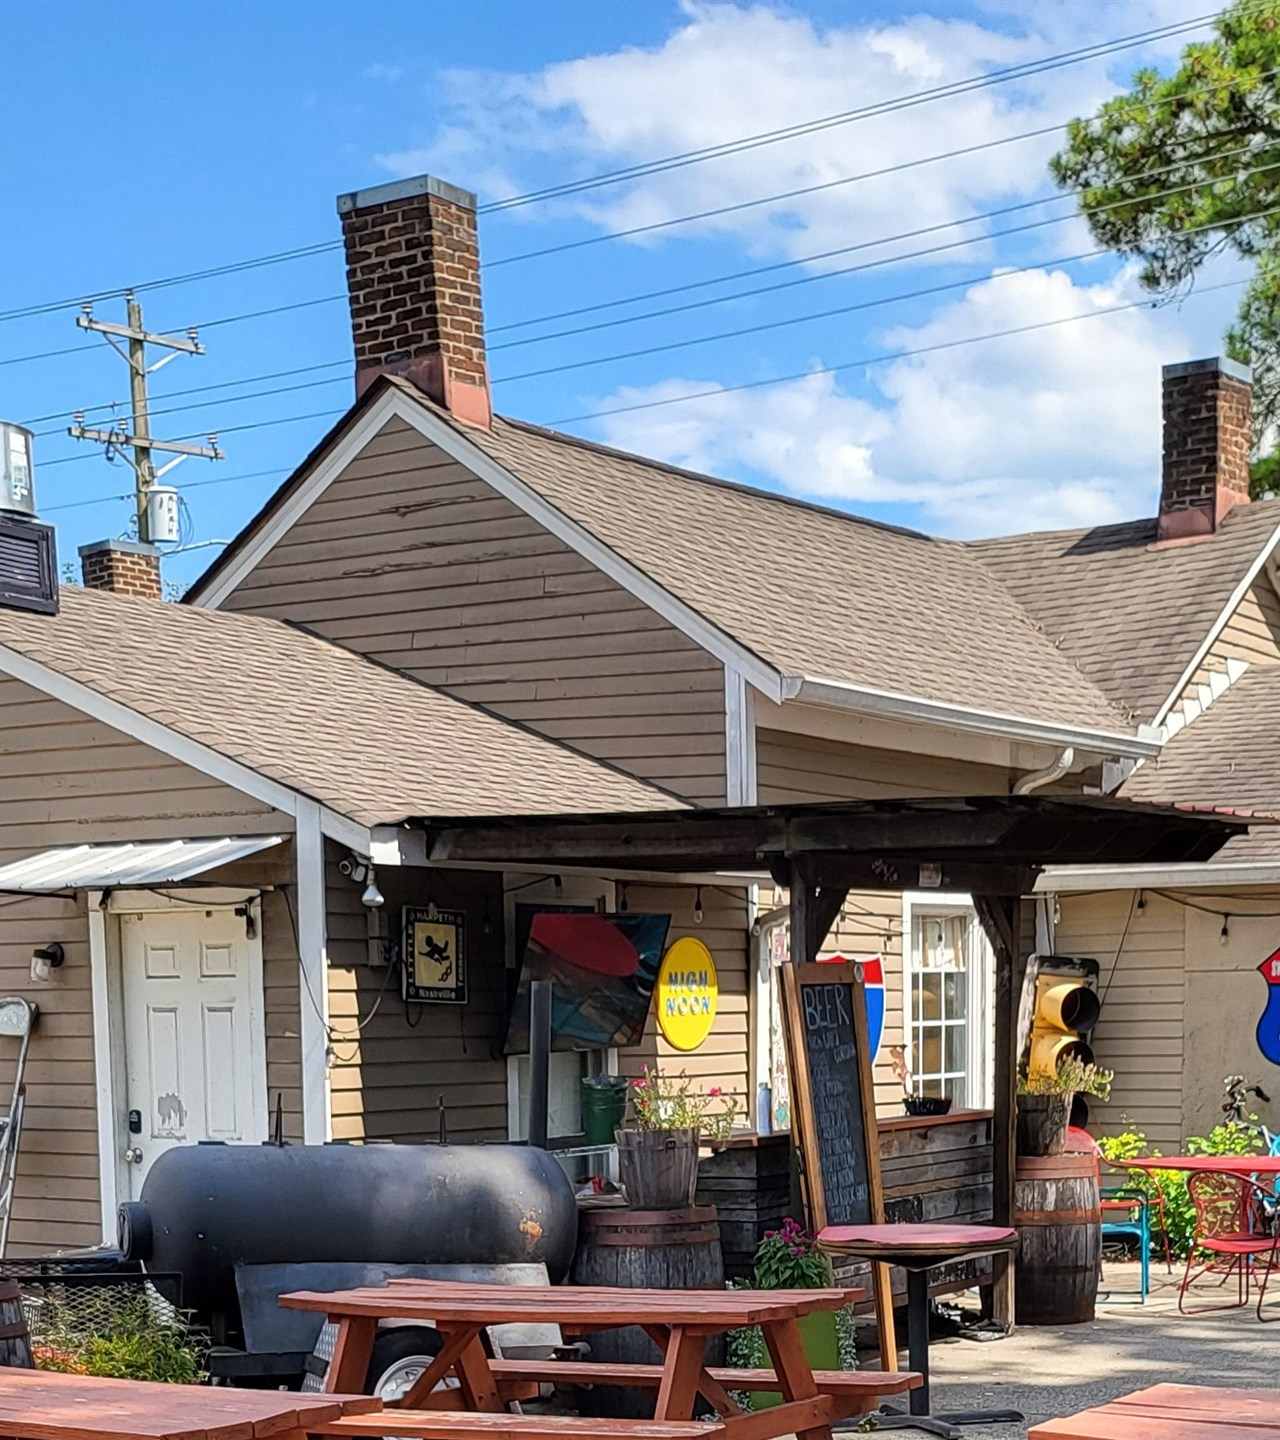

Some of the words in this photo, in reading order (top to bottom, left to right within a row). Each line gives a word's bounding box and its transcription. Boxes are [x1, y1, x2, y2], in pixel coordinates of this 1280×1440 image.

[668, 970, 708, 993] HIGH
[666, 996, 710, 1017] NOON
[803, 985, 850, 1030] BEER
